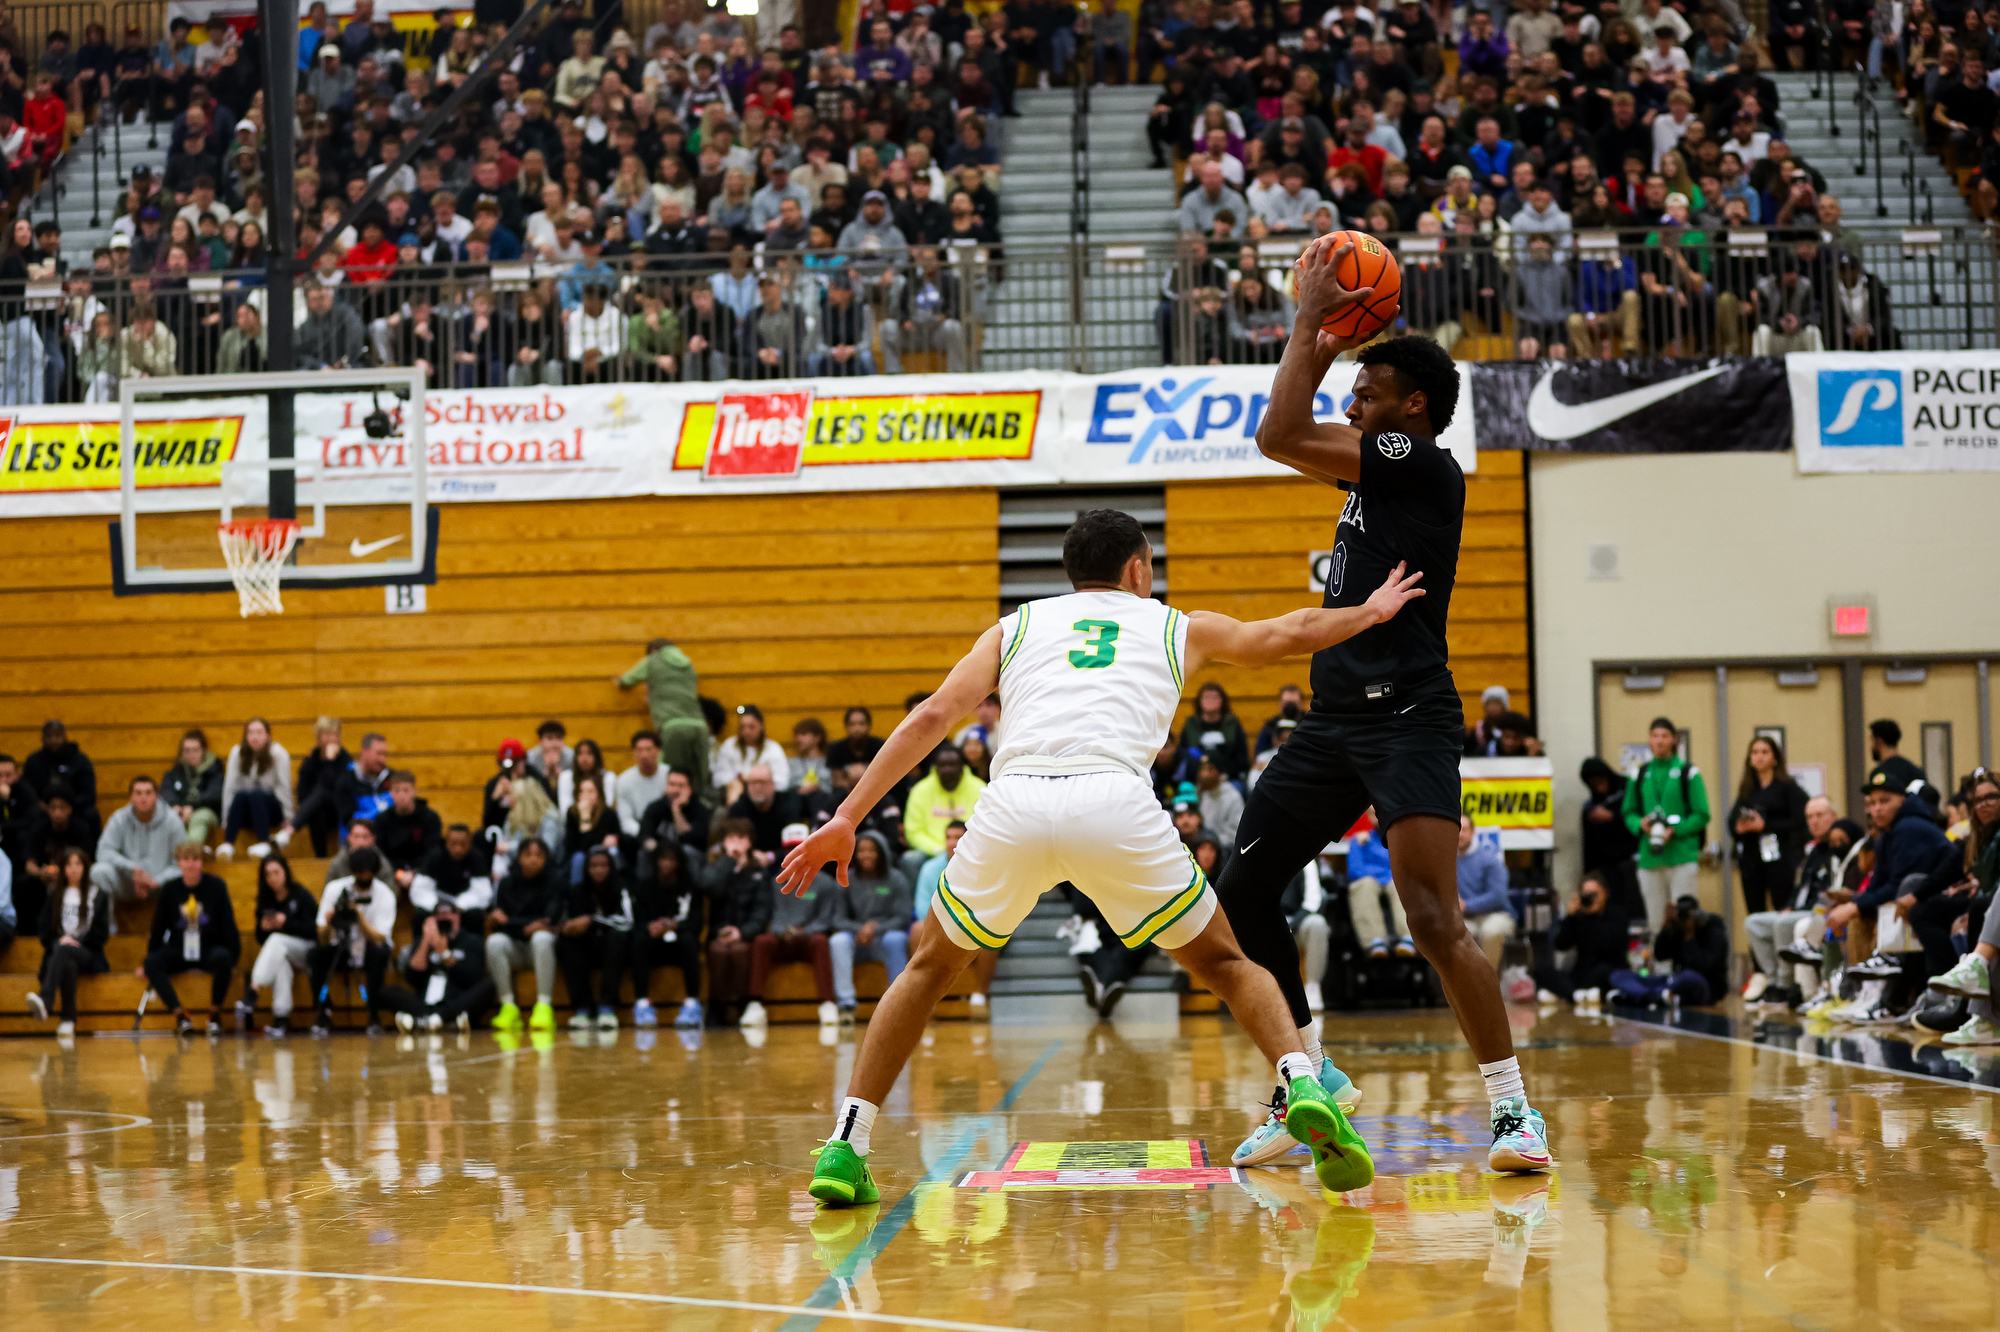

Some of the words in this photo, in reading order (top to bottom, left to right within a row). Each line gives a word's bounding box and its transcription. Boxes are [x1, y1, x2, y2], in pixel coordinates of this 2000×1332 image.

[340, 401, 404, 430] Ls
[424, 394, 566, 424] Schwab
[720, 402, 804, 456] Tires
[814, 414, 868, 445] LES
[877, 412, 1021, 443] SCHWAB
[1913, 405, 2000, 430] AUTO
[8, 442, 65, 472] LES
[320, 428, 584, 468] Inviational
[1330, 541, 1347, 597] 0
[1066, 618, 1121, 670] 3
